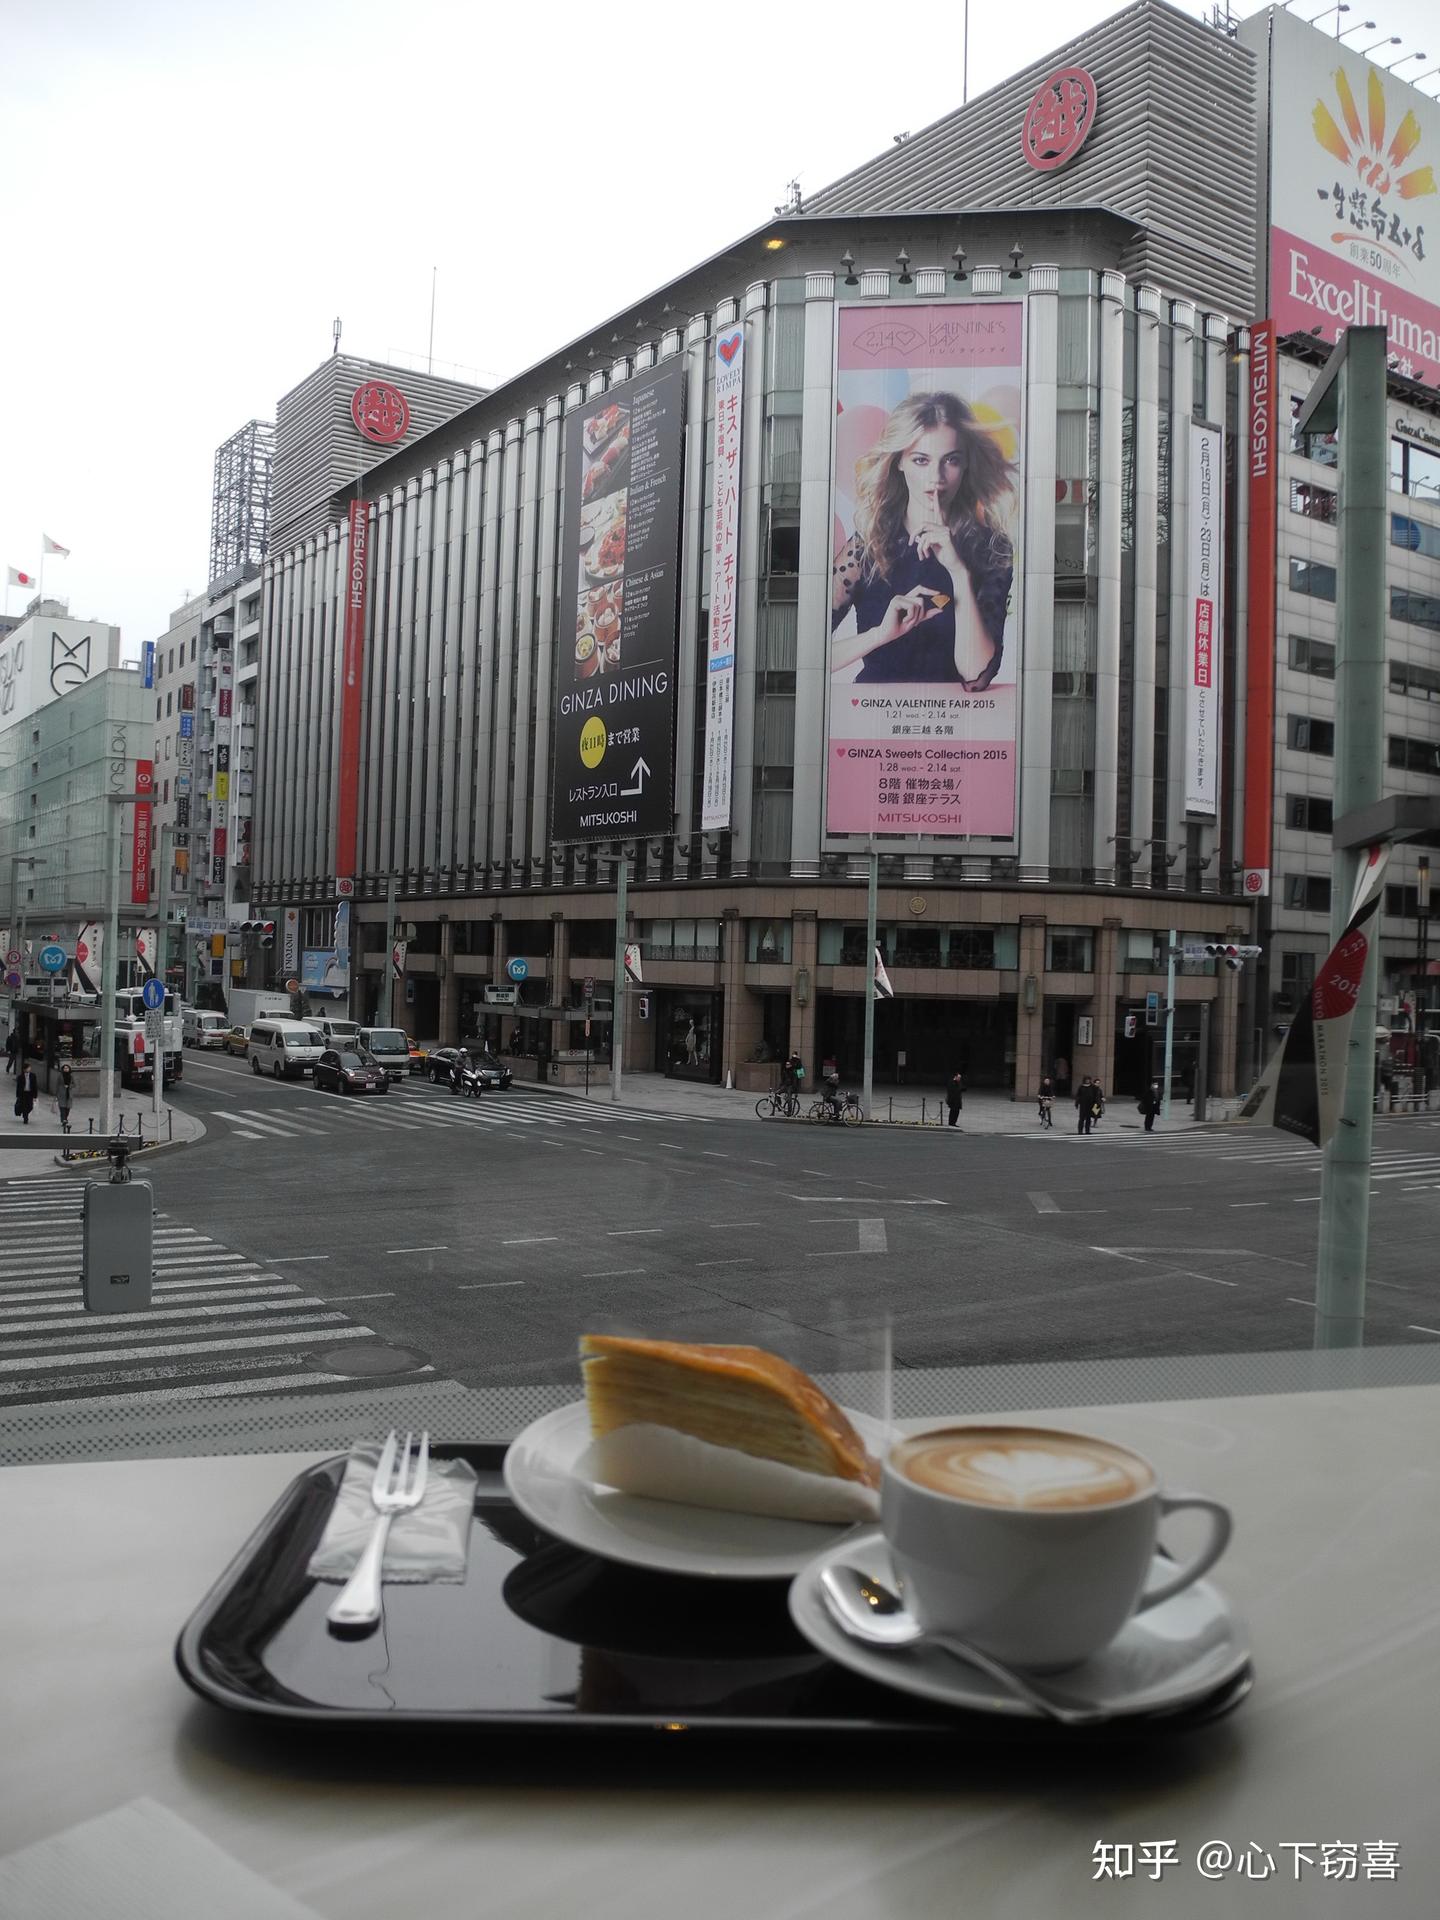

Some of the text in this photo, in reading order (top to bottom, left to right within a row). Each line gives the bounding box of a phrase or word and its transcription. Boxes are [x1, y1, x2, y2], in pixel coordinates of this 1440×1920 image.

[1289, 248, 1440, 364] ExcelHuma
[716, 368, 741, 386] LOVELY
[1253, 331, 1268, 478] MITSUKOSHI
[351, 508, 366, 609] MITSUKOSHI
[561, 672, 668, 715] GINZA DINING
[861, 699, 995, 709] GINZA VALENTINE FAIR 2015
[892, 725, 954, 735] 銀座三越 各階
[848, 749, 1008, 760] GINZA Sweets Collection 2015
[569, 783, 618, 803] レストラン入口
[879, 778, 901, 790] 8階
[878, 793, 961, 805] 9階 銀座テラス
[580, 810, 637, 828] MITSUKOSHI
[877, 813, 962, 824] MITSUKOSHI
[1328, 974, 1361, 999] 2015
